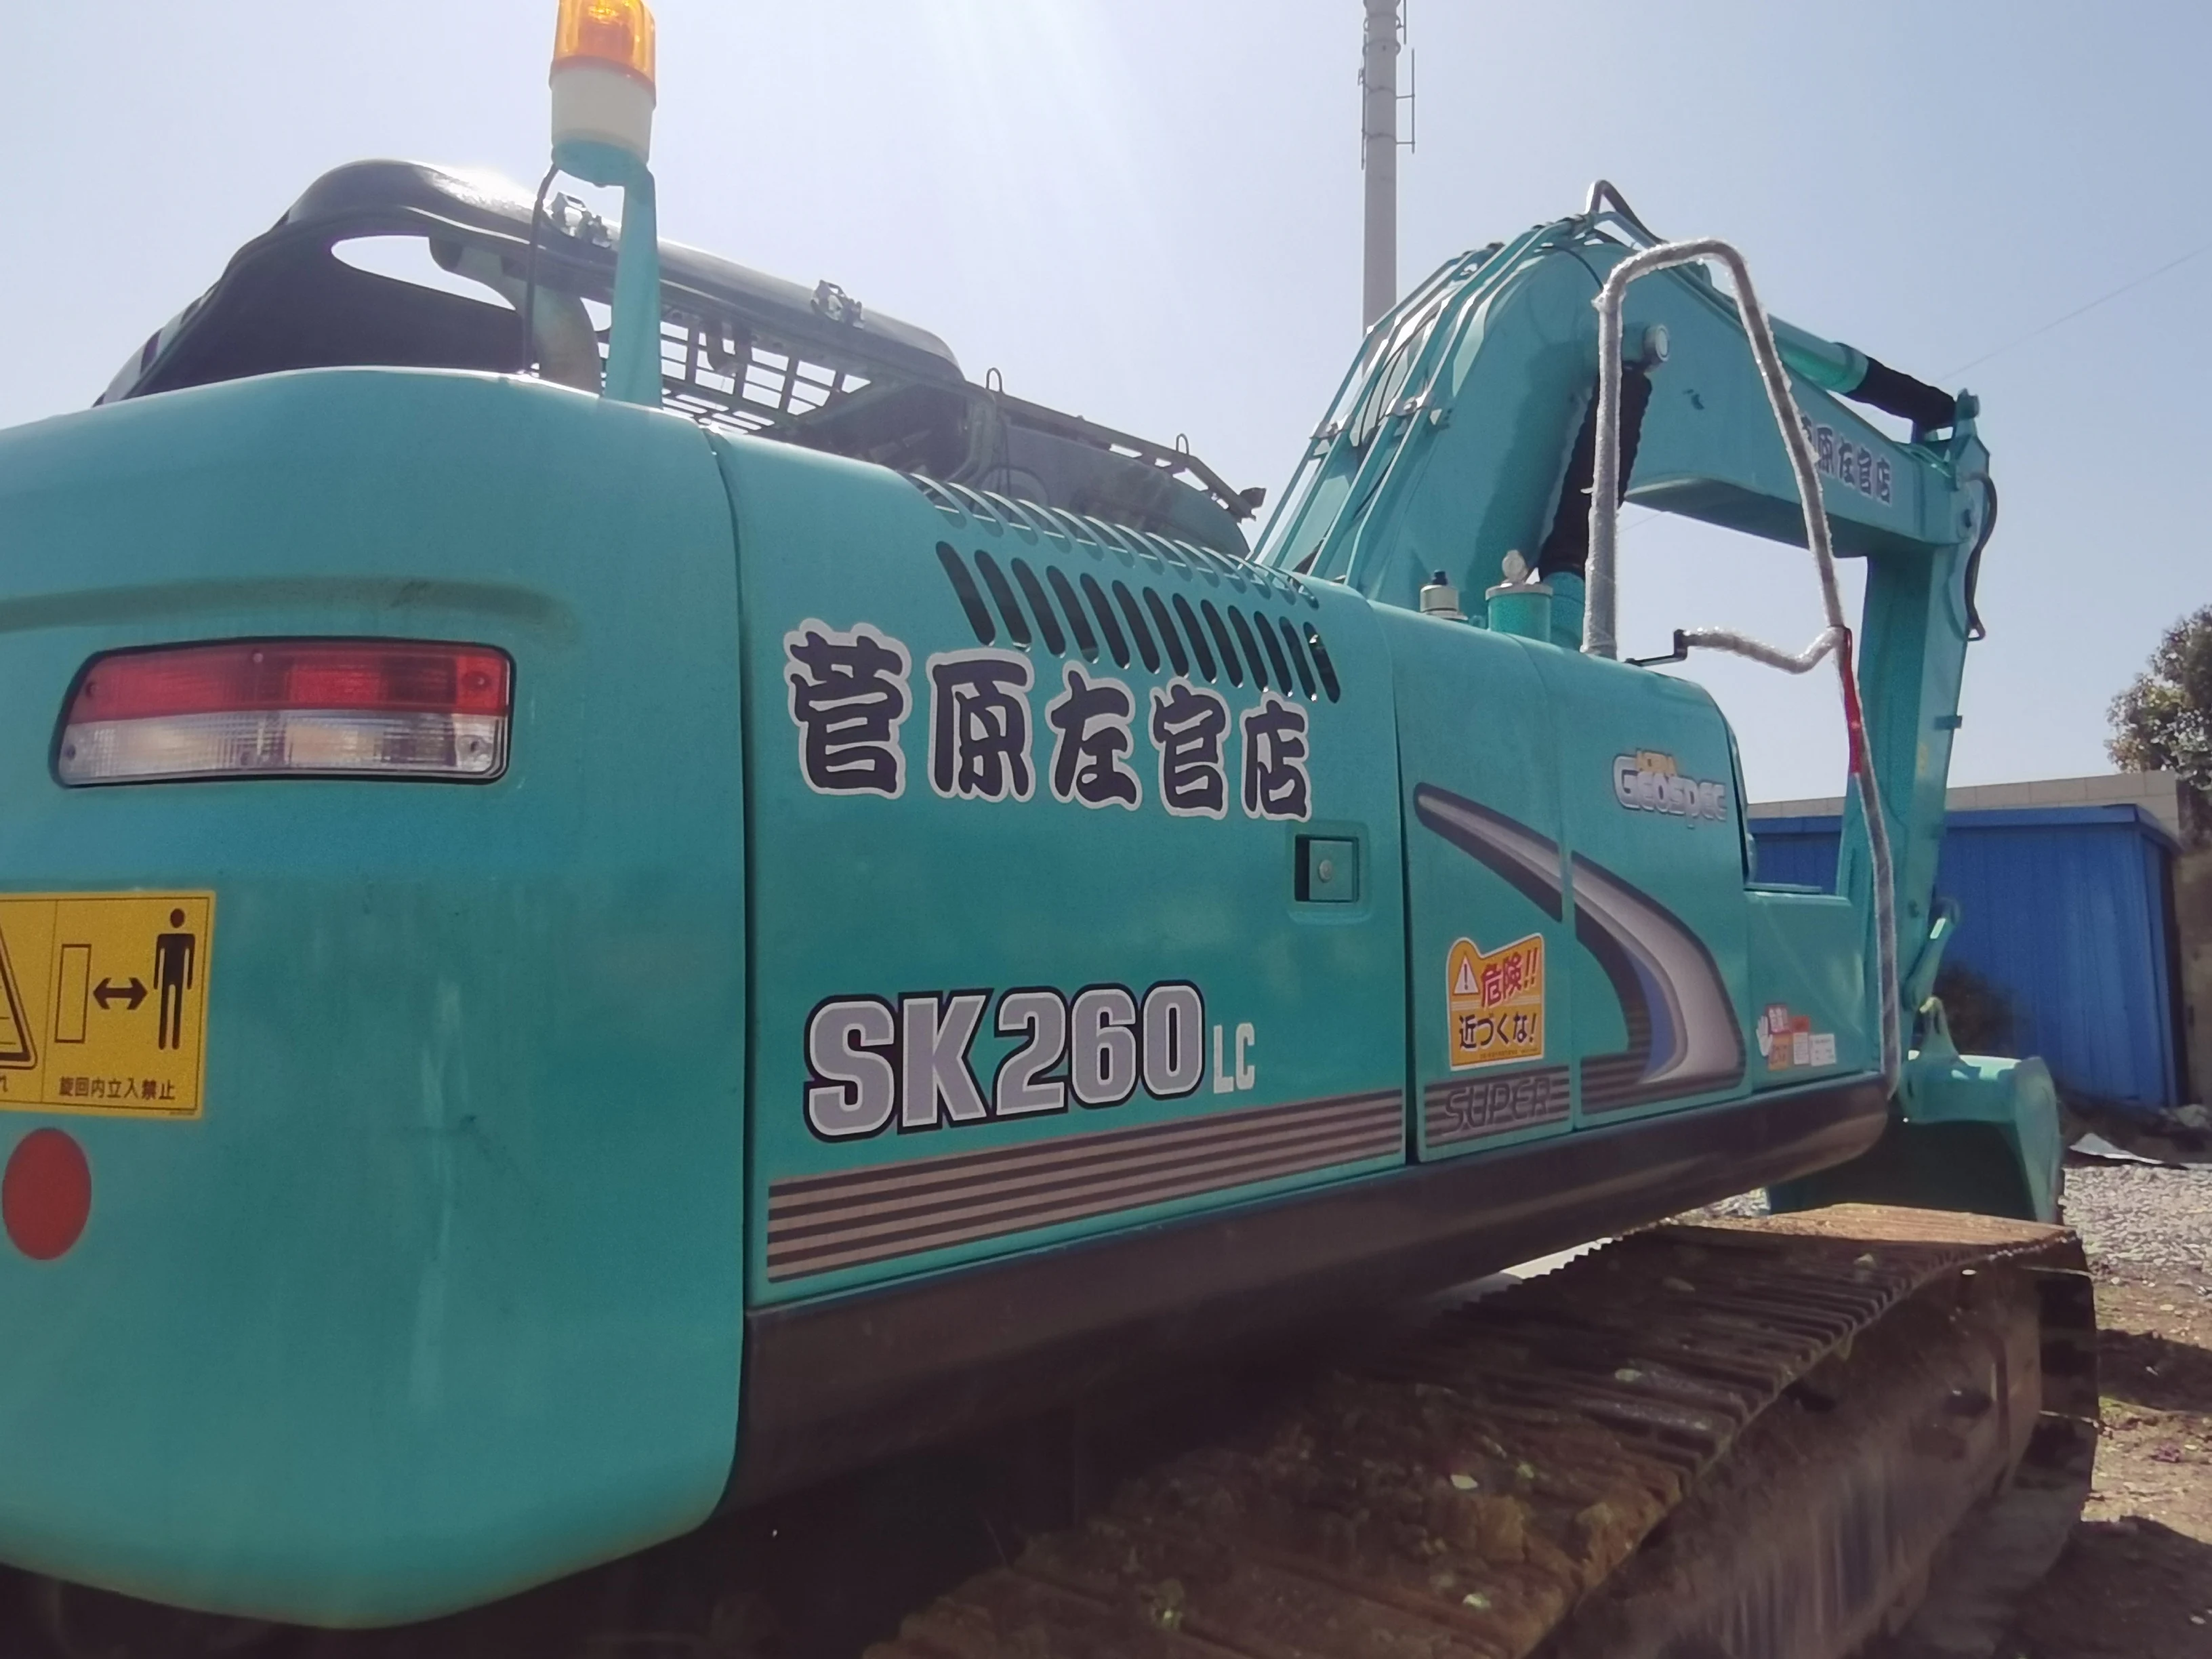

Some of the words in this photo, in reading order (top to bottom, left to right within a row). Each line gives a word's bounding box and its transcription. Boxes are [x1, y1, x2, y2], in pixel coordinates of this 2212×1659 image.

[1801, 413, 1892, 506] 原左官店
[784, 618, 1312, 821] 菅原左官店
[58, 1076, 176, 1101] 旋回内立入禁止
[803, 979, 1206, 1143] SK260
[1212, 1022, 1255, 1094] LC
[1445, 1077, 1552, 1134] SUPER
